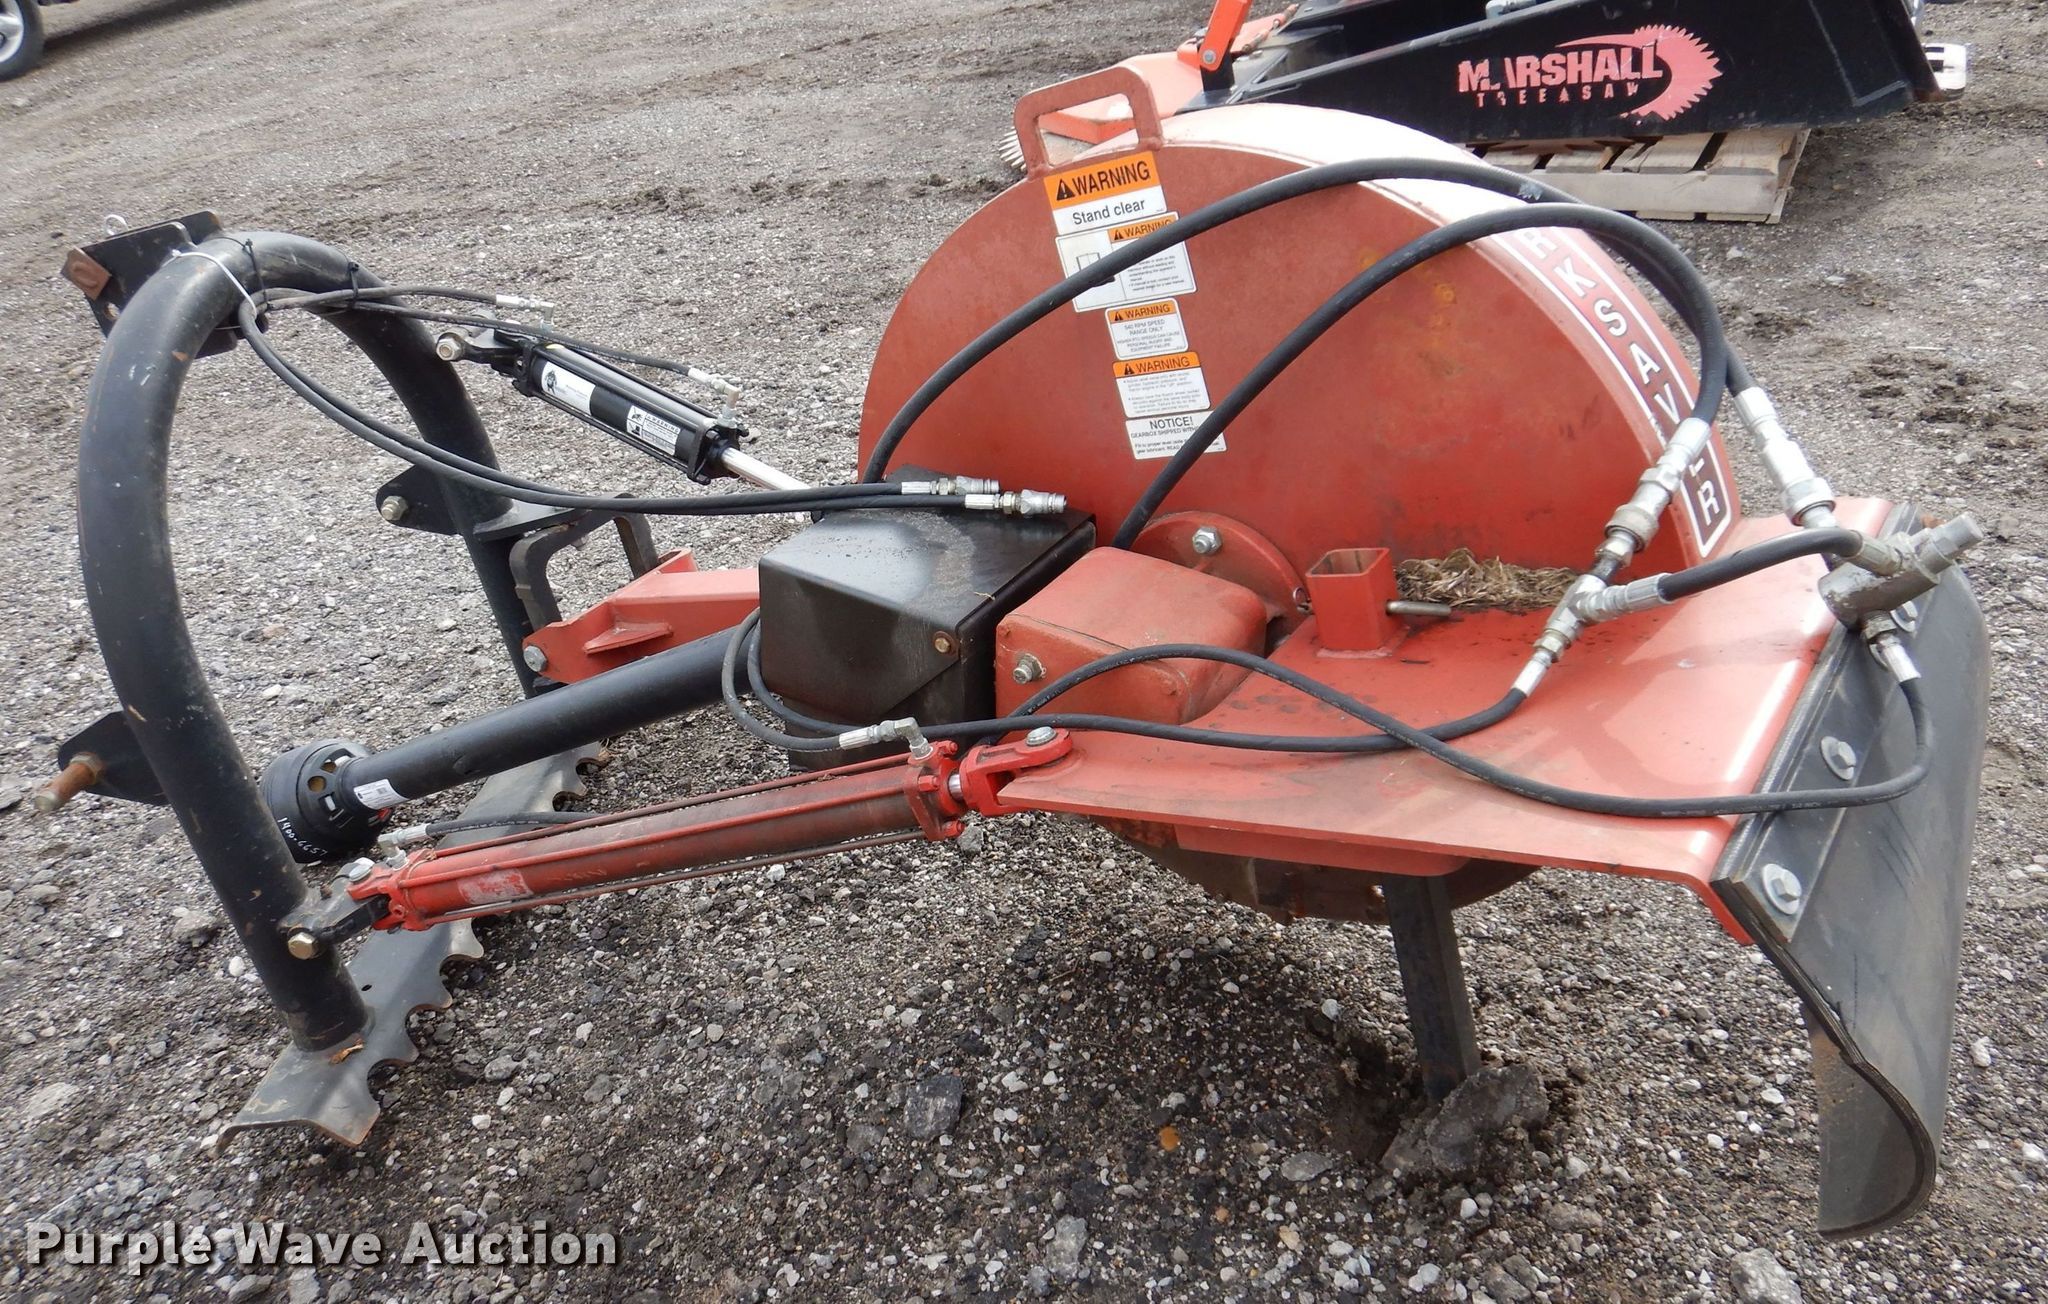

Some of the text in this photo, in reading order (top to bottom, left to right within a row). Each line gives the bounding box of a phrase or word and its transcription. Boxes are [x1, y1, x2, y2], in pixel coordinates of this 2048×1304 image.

[1072, 160, 1151, 196] WARNING
[1072, 200, 1145, 225] Stand clear
[1125, 303, 1171, 319] WARNING
[1136, 356, 1191, 374] WARNING
[1149, 416, 1194, 430] NOTICE!
